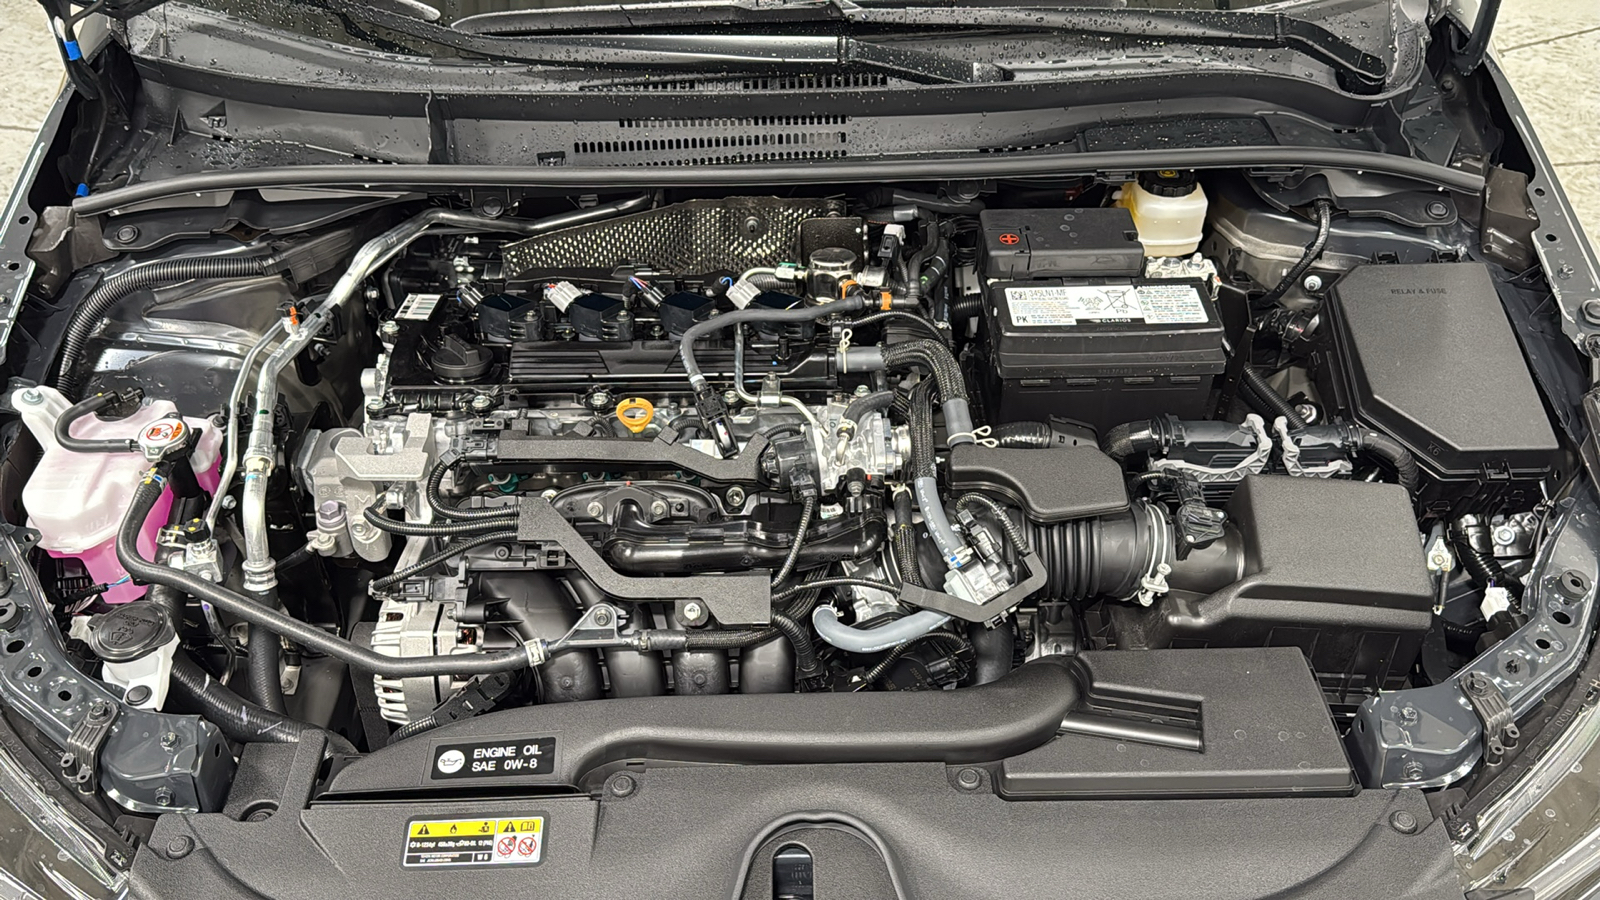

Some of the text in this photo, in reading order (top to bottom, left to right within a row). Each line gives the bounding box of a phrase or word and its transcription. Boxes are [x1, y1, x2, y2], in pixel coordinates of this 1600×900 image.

[1426, 287, 1448, 295] FUSE
[1016, 315, 1028, 323] PK
[473, 744, 542, 759] ENGINE OIL
[471, 758, 537, 772] SAE 0W-8
